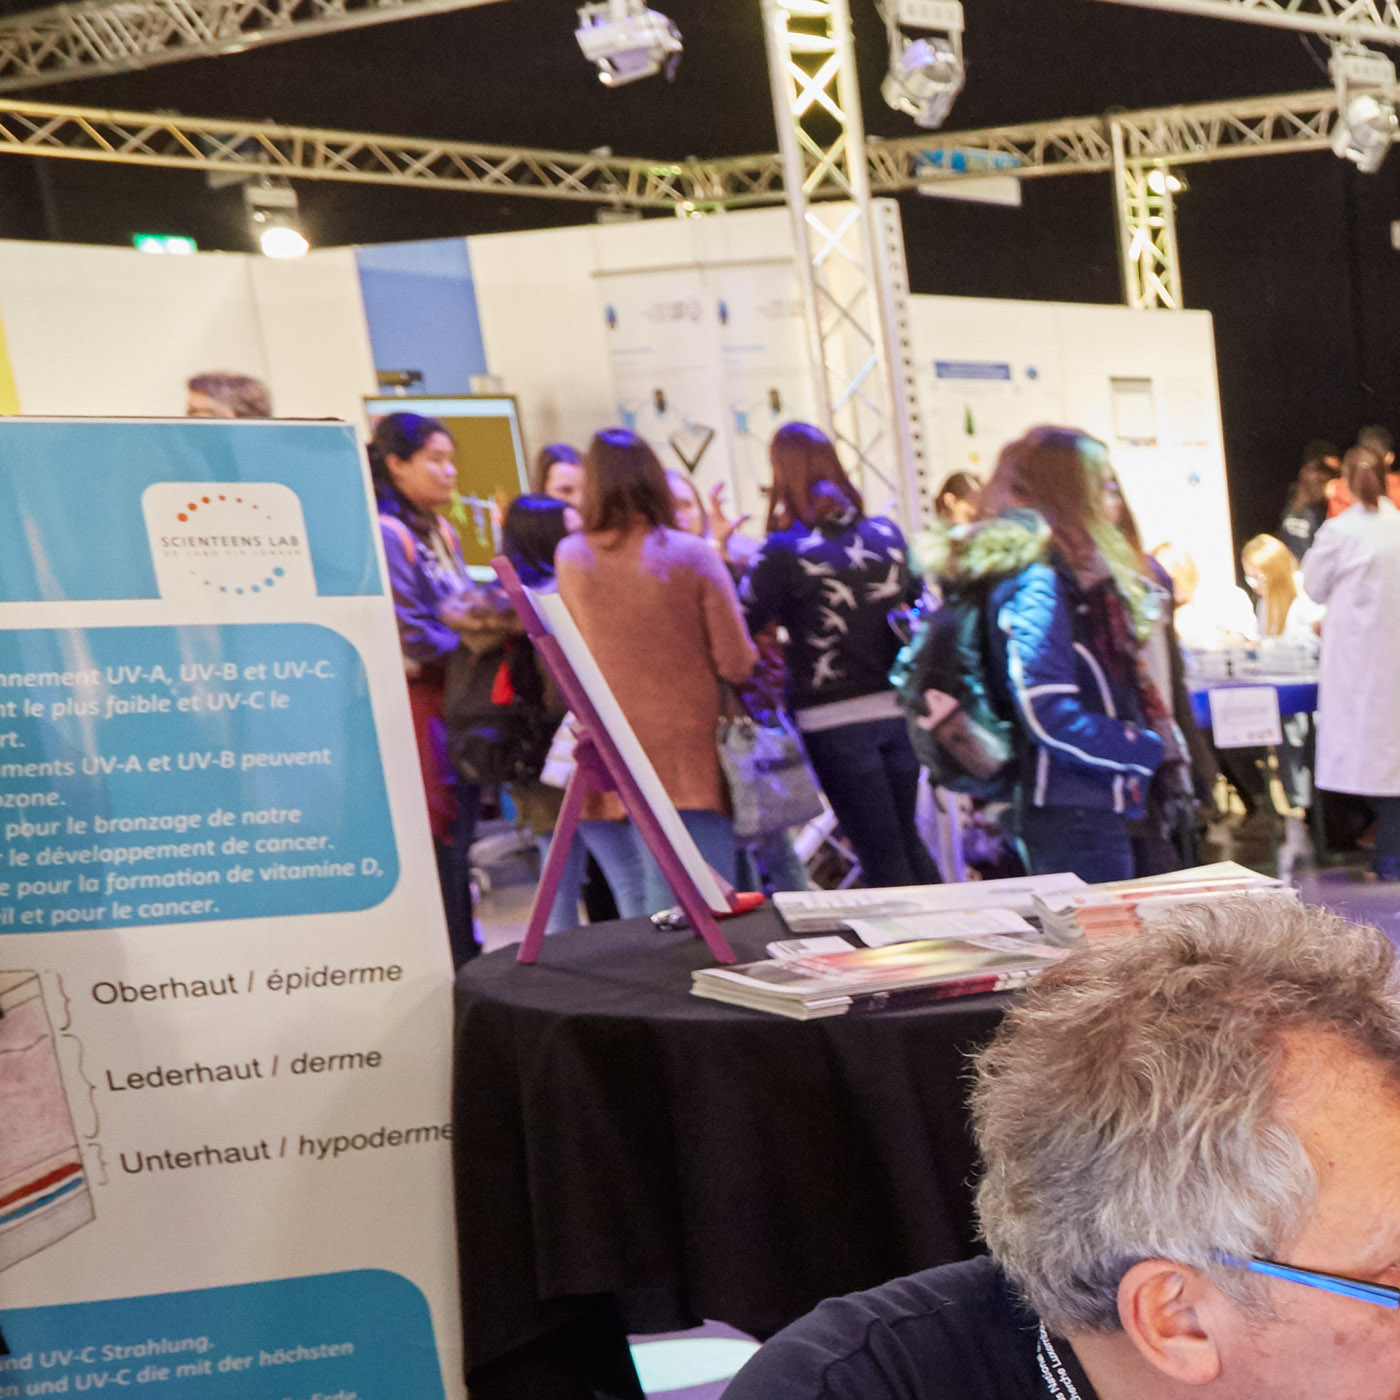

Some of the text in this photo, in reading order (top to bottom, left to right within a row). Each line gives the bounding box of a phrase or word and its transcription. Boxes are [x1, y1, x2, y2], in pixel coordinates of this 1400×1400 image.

[161, 535, 299, 548] SCIENTEENS LAB
[106, 665, 173, 685] UV-A,
[180, 663, 238, 682] UV-B
[244, 662, 267, 680] et
[274, 660, 336, 680] UV-C.
[24, 698, 45, 717] le
[51, 697, 100, 720] plus
[104, 694, 172, 719] faible
[177, 694, 201, 712] et
[207, 690, 265, 711] UV-C
[271, 689, 290, 709] le
[82, 754, 143, 776] UV-A
[148, 753, 171, 772] et
[178, 750, 237, 771] UV-B
[241, 748, 331, 771] peuvent
[0, 791, 67, 808] zone.
[5, 807, 302, 841] pour le bronzage de notre
[9, 834, 335, 867] le développement de cancer.
[17, 878, 72, 901] pour
[78, 873, 100, 893] la
[104, 868, 221, 896] formation
[226, 864, 254, 884] de
[259, 858, 355, 882] vitamine
[360, 857, 384, 879] D,
[21, 907, 44, 926] et
[50, 904, 106, 928] pour
[112, 900, 132, 920] le
[138, 899, 221, 919] cancer.
[92, 973, 238, 1004] Oberhaut
[266, 963, 404, 1000] épiderme
[106, 1058, 262, 1091] Lederhaut
[290, 1047, 384, 1076] derme
[120, 1138, 272, 1174] Unterhaut
[299, 1119, 454, 1160] hypoderme
[26, 1375, 69, 1396] und
[75, 1368, 132, 1391] UV-C
[137, 1364, 170, 1384] die
[176, 1360, 212, 1379] mit
[217, 1355, 254, 1374] der
[258, 1340, 354, 1368] höchsten
[39, 1346, 97, 1369] UV-C
[102, 1336, 216, 1363] Strahlung.
